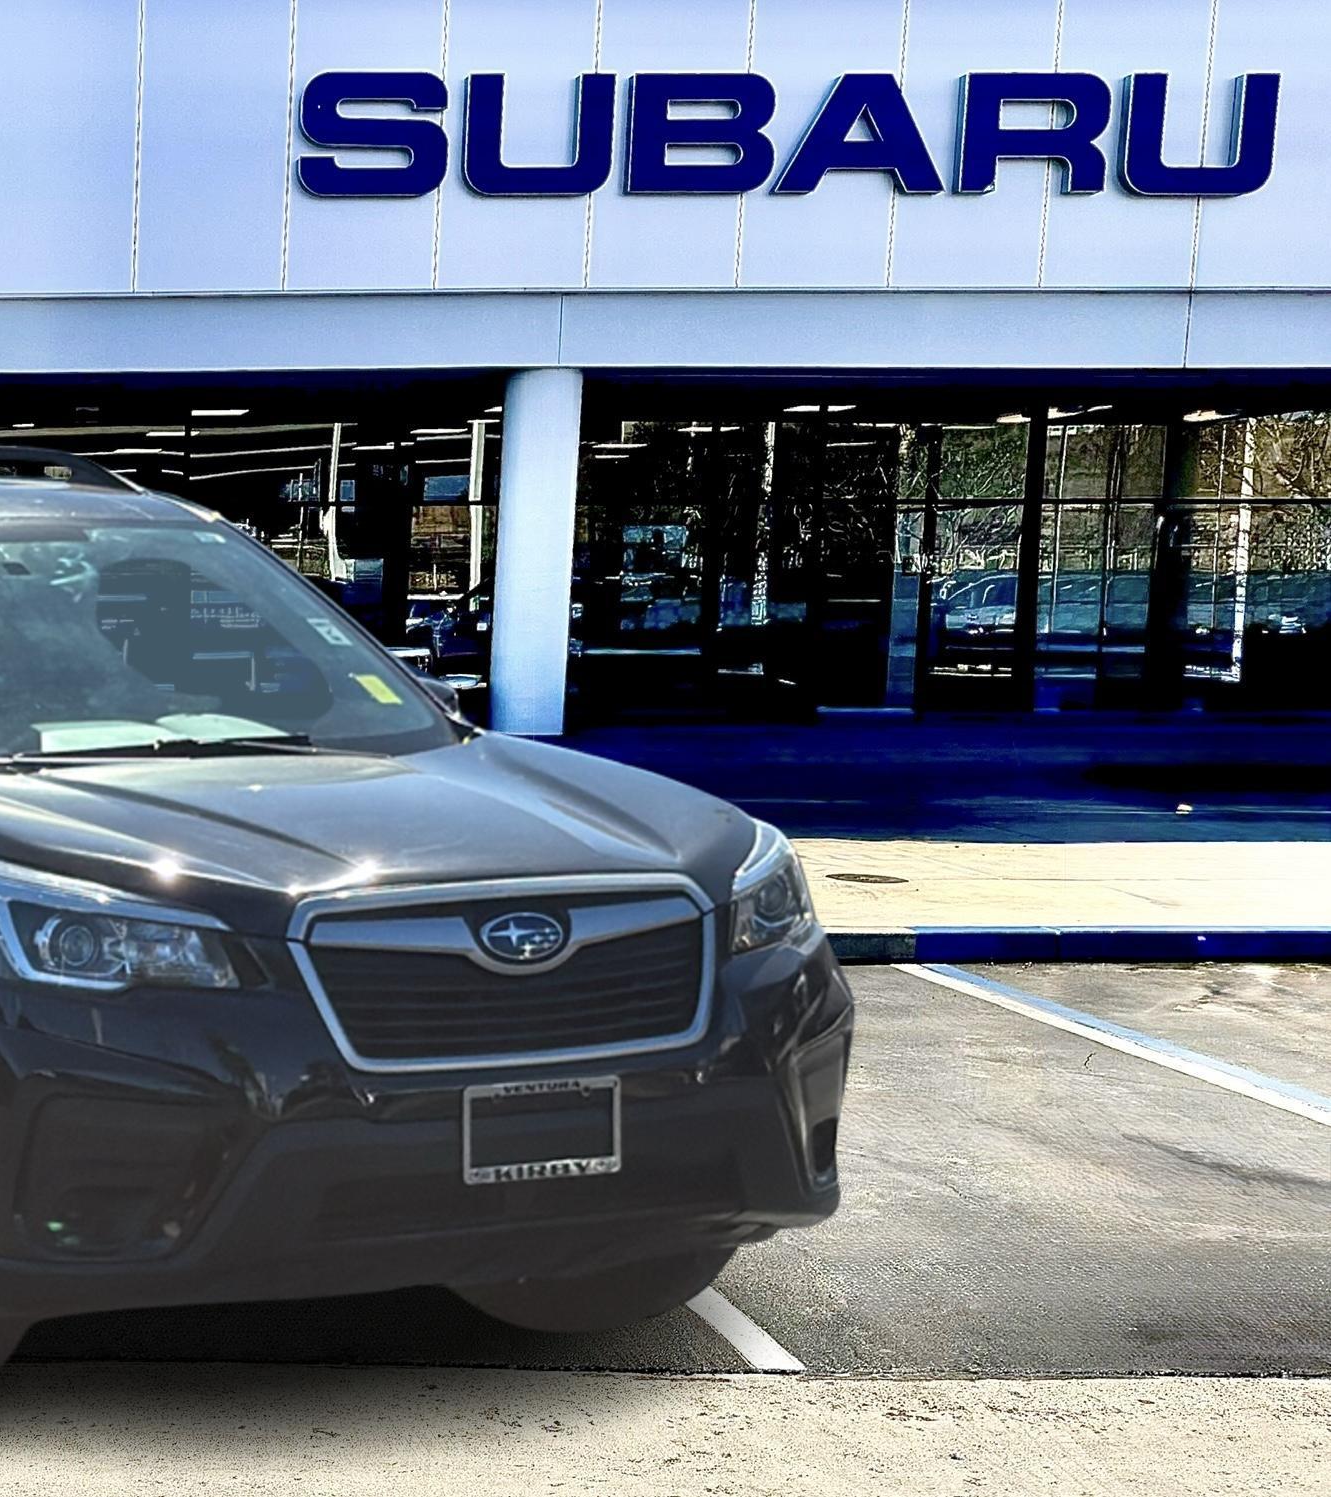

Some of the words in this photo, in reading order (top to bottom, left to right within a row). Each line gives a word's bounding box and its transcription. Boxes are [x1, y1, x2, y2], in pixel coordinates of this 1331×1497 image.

[295, 70, 1282, 198] SUBARU
[503, 1080, 581, 1095] VENTURA
[494, 1161, 591, 1182] KIRBY
